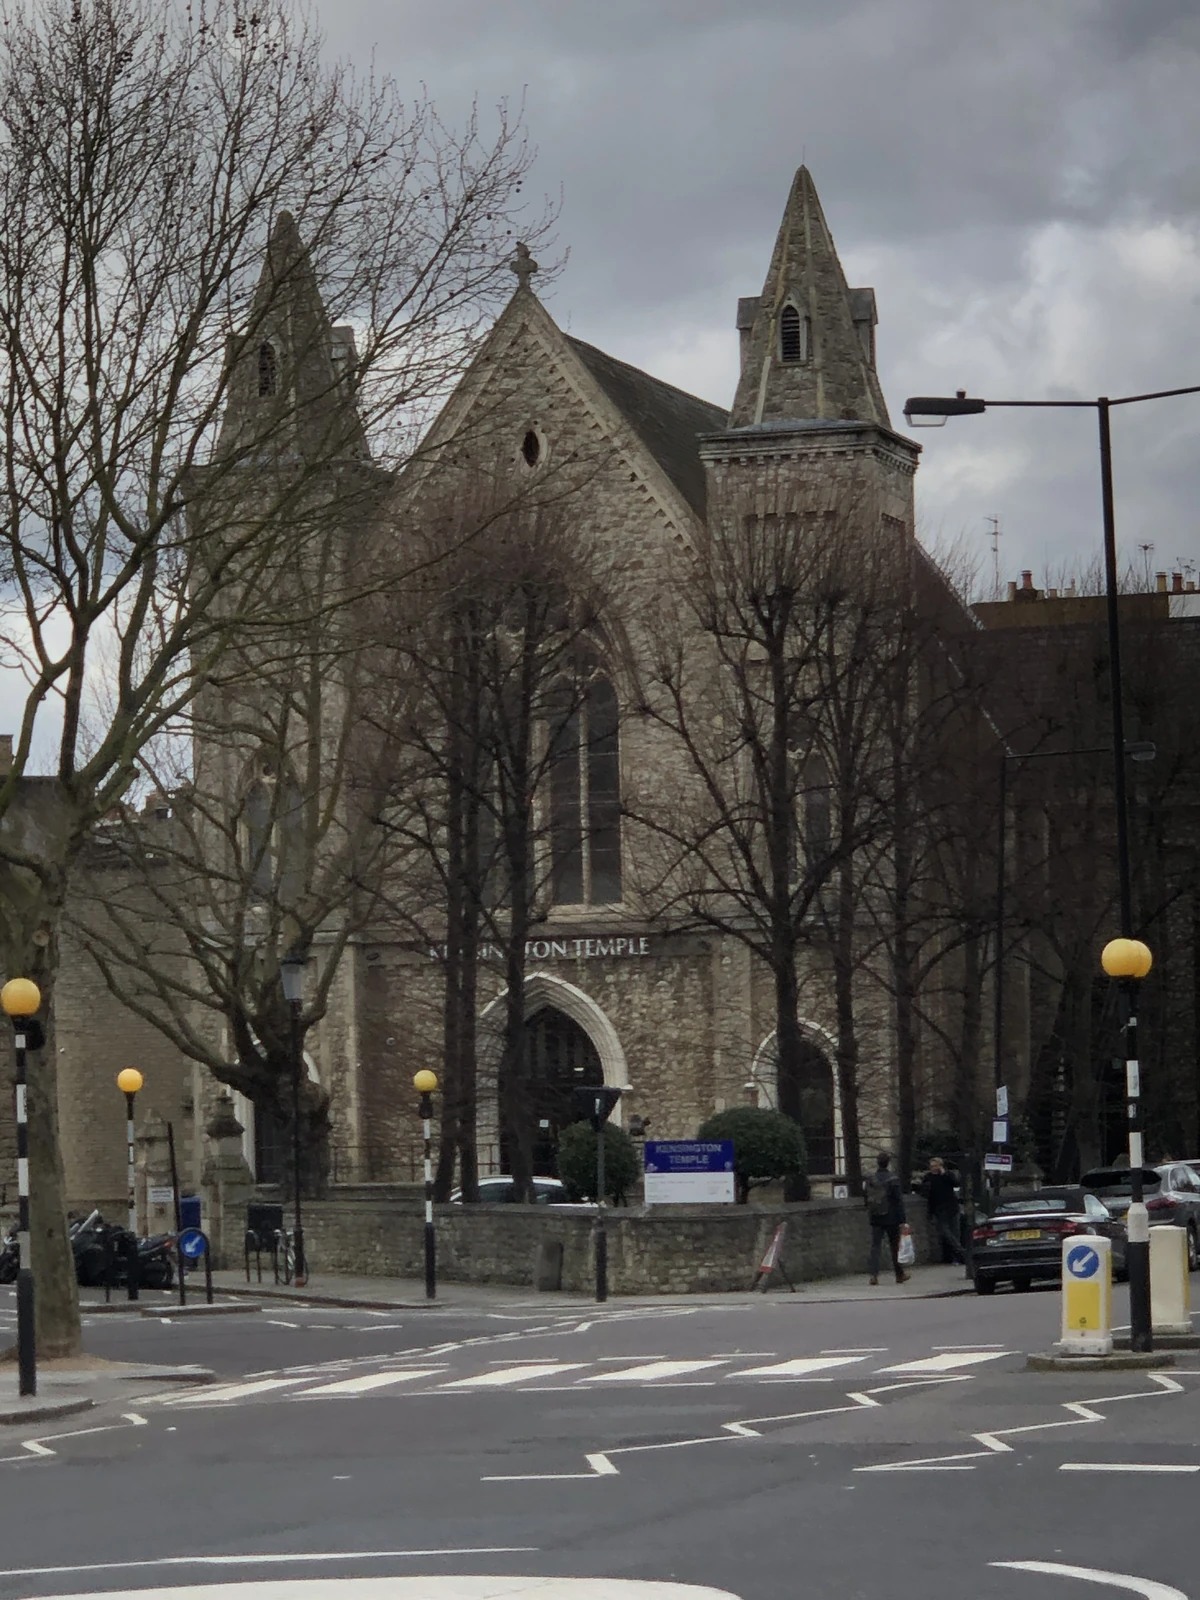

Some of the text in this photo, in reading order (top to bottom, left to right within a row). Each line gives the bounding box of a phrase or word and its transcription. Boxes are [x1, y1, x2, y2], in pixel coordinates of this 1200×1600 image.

[428, 937, 650, 961] KINTON TEMPLE
[656, 1144, 722, 1153] KENSINGTON
[670, 1155, 709, 1164] TEMPLE
